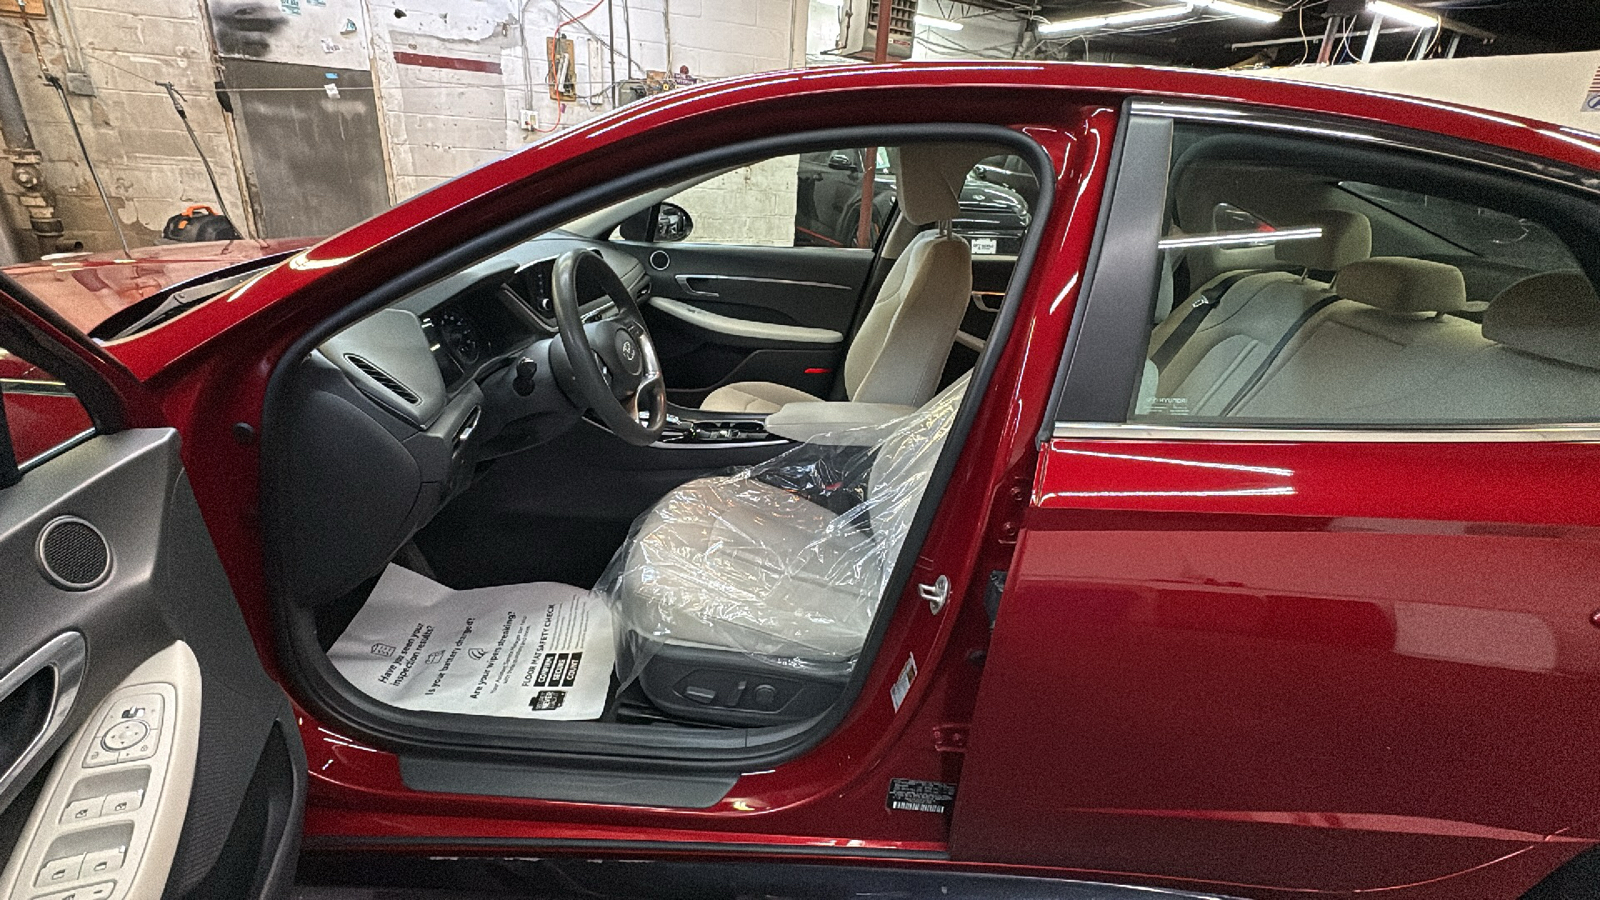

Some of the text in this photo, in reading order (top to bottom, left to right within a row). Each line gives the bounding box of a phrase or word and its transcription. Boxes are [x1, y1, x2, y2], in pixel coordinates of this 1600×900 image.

[544, 603, 556, 628] CHECK
[536, 627, 549, 652] SAFETY
[378, 664, 397, 683] Have
[401, 638, 415, 655] seen
[411, 622, 424, 639] your
[390, 625, 435, 686] inspection results?
[438, 647, 462, 671] battery
[469, 611, 517, 699] Are your wipers streaking?
[530, 651, 543, 665] MAT
[431, 672, 446, 688] your
[521, 665, 537, 687] FLOOR
[537, 656, 554, 683] CONFIRM
[552, 659, 566, 681] SECURE
[566, 659, 579, 681] COUNT
[424, 687, 436, 696] Is
